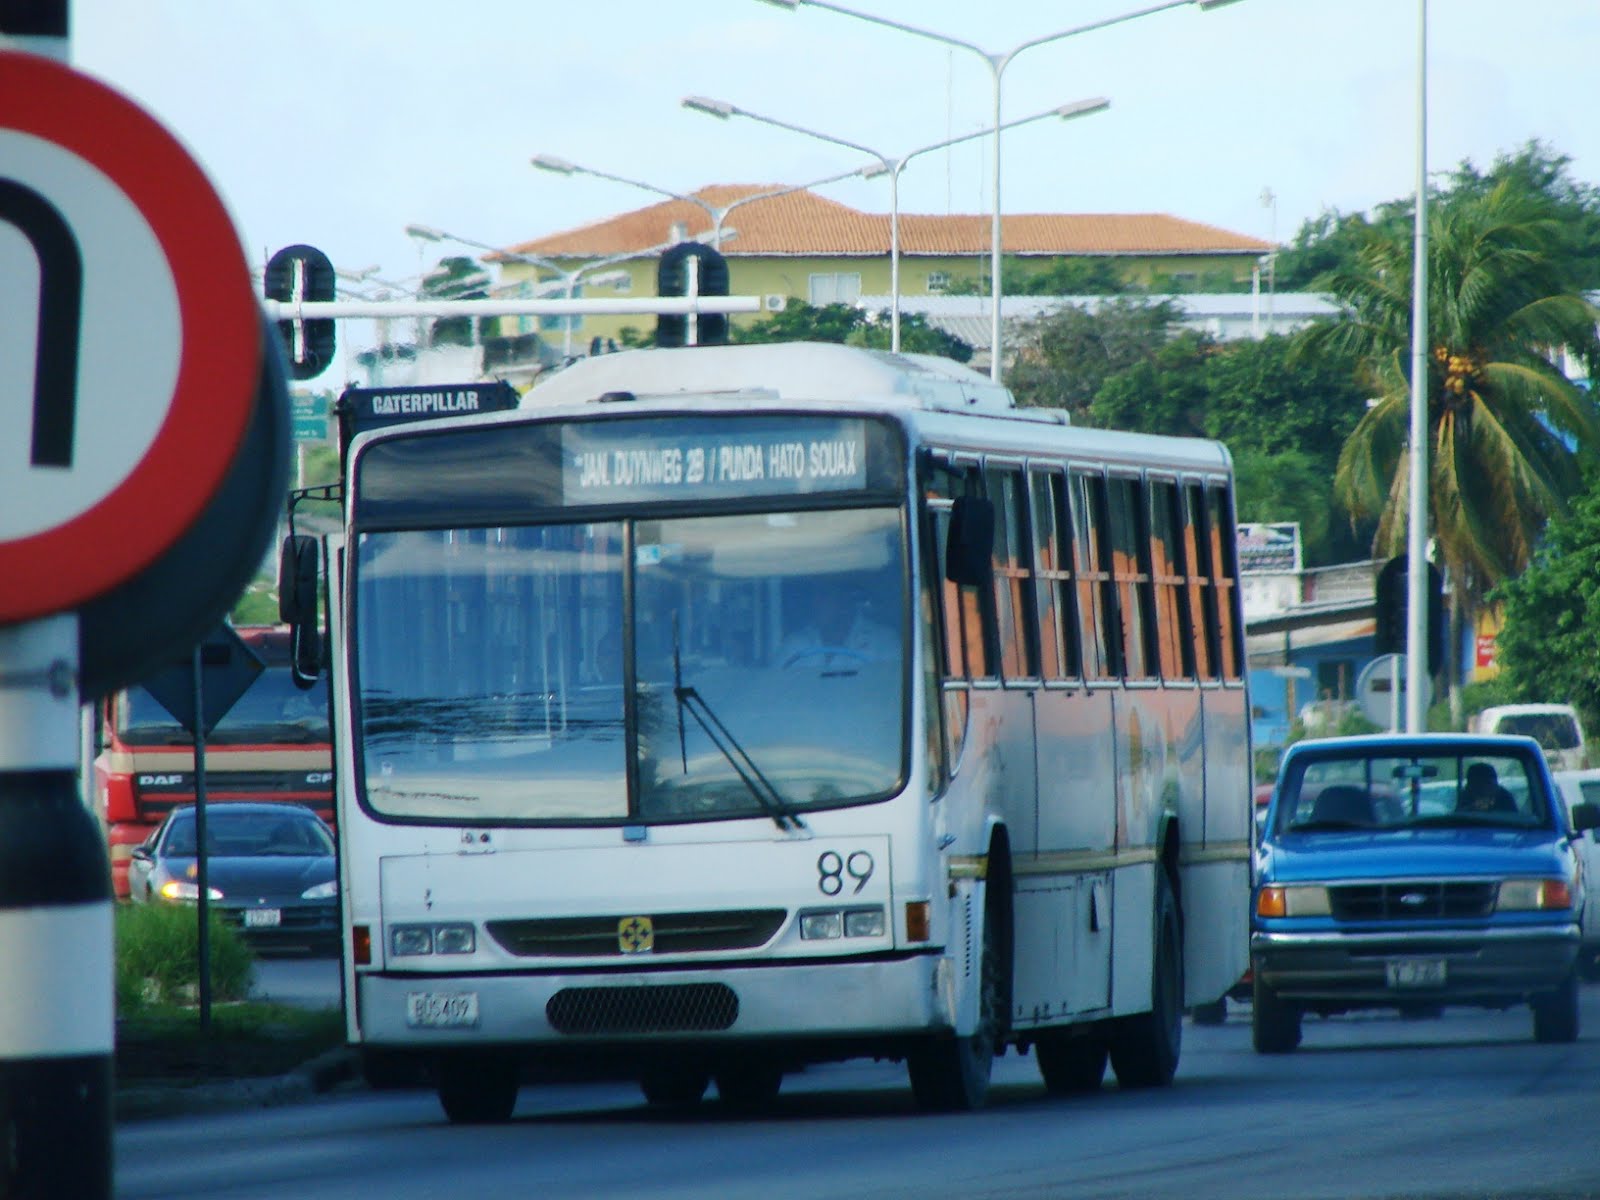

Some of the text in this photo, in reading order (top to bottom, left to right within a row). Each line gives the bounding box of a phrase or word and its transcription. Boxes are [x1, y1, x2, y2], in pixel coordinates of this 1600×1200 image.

[372, 391, 479, 414] CATERPILLAR
[720, 444, 764, 481] PUNDA
[769, 442, 805, 479] HATO
[139, 774, 183, 785] DAF
[817, 850, 874, 896] 89
